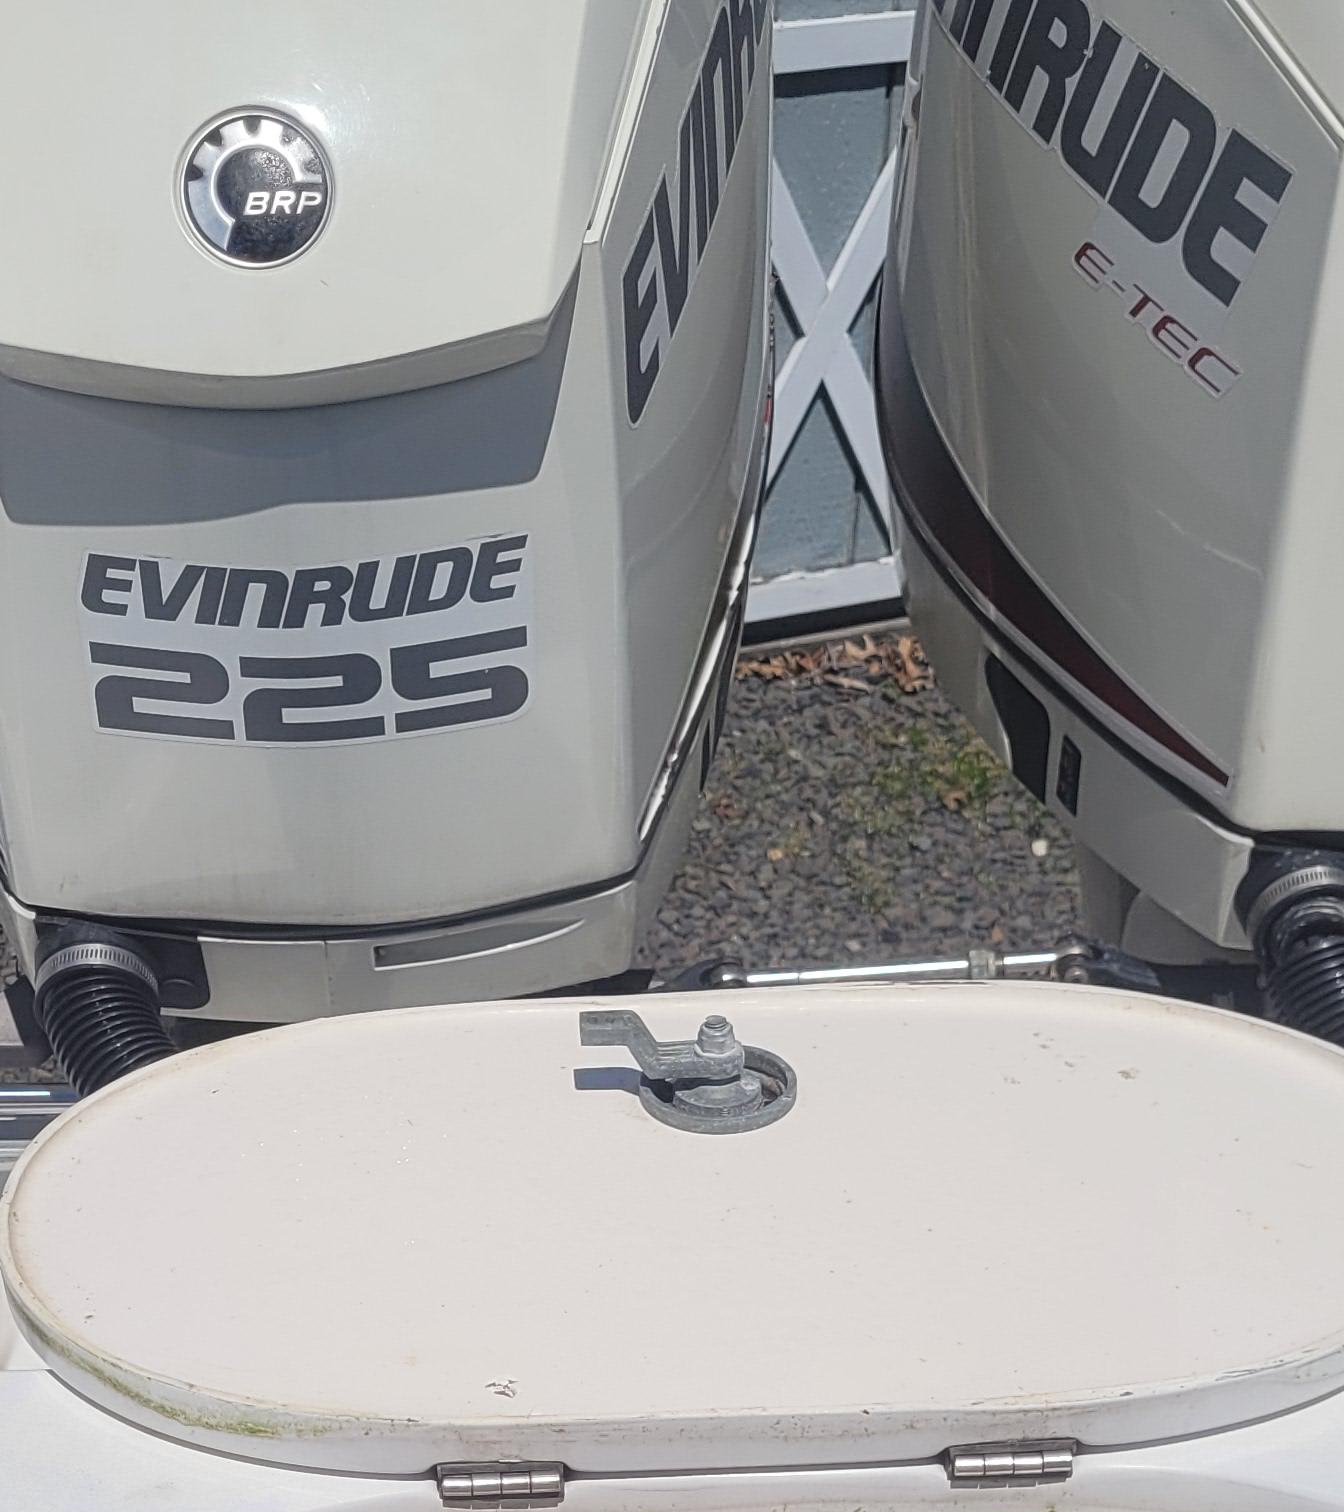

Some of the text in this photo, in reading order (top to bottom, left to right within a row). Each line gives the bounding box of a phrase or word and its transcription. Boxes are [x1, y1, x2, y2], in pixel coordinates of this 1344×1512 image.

[243, 190, 323, 216] BRP
[622, 0, 768, 426] EVINR
[933, 0, 1294, 308] NRUDE
[1074, 241, 1240, 394] E-TEC
[80, 533, 529, 630] EVINRUDE
[88, 625, 529, 742] 225
